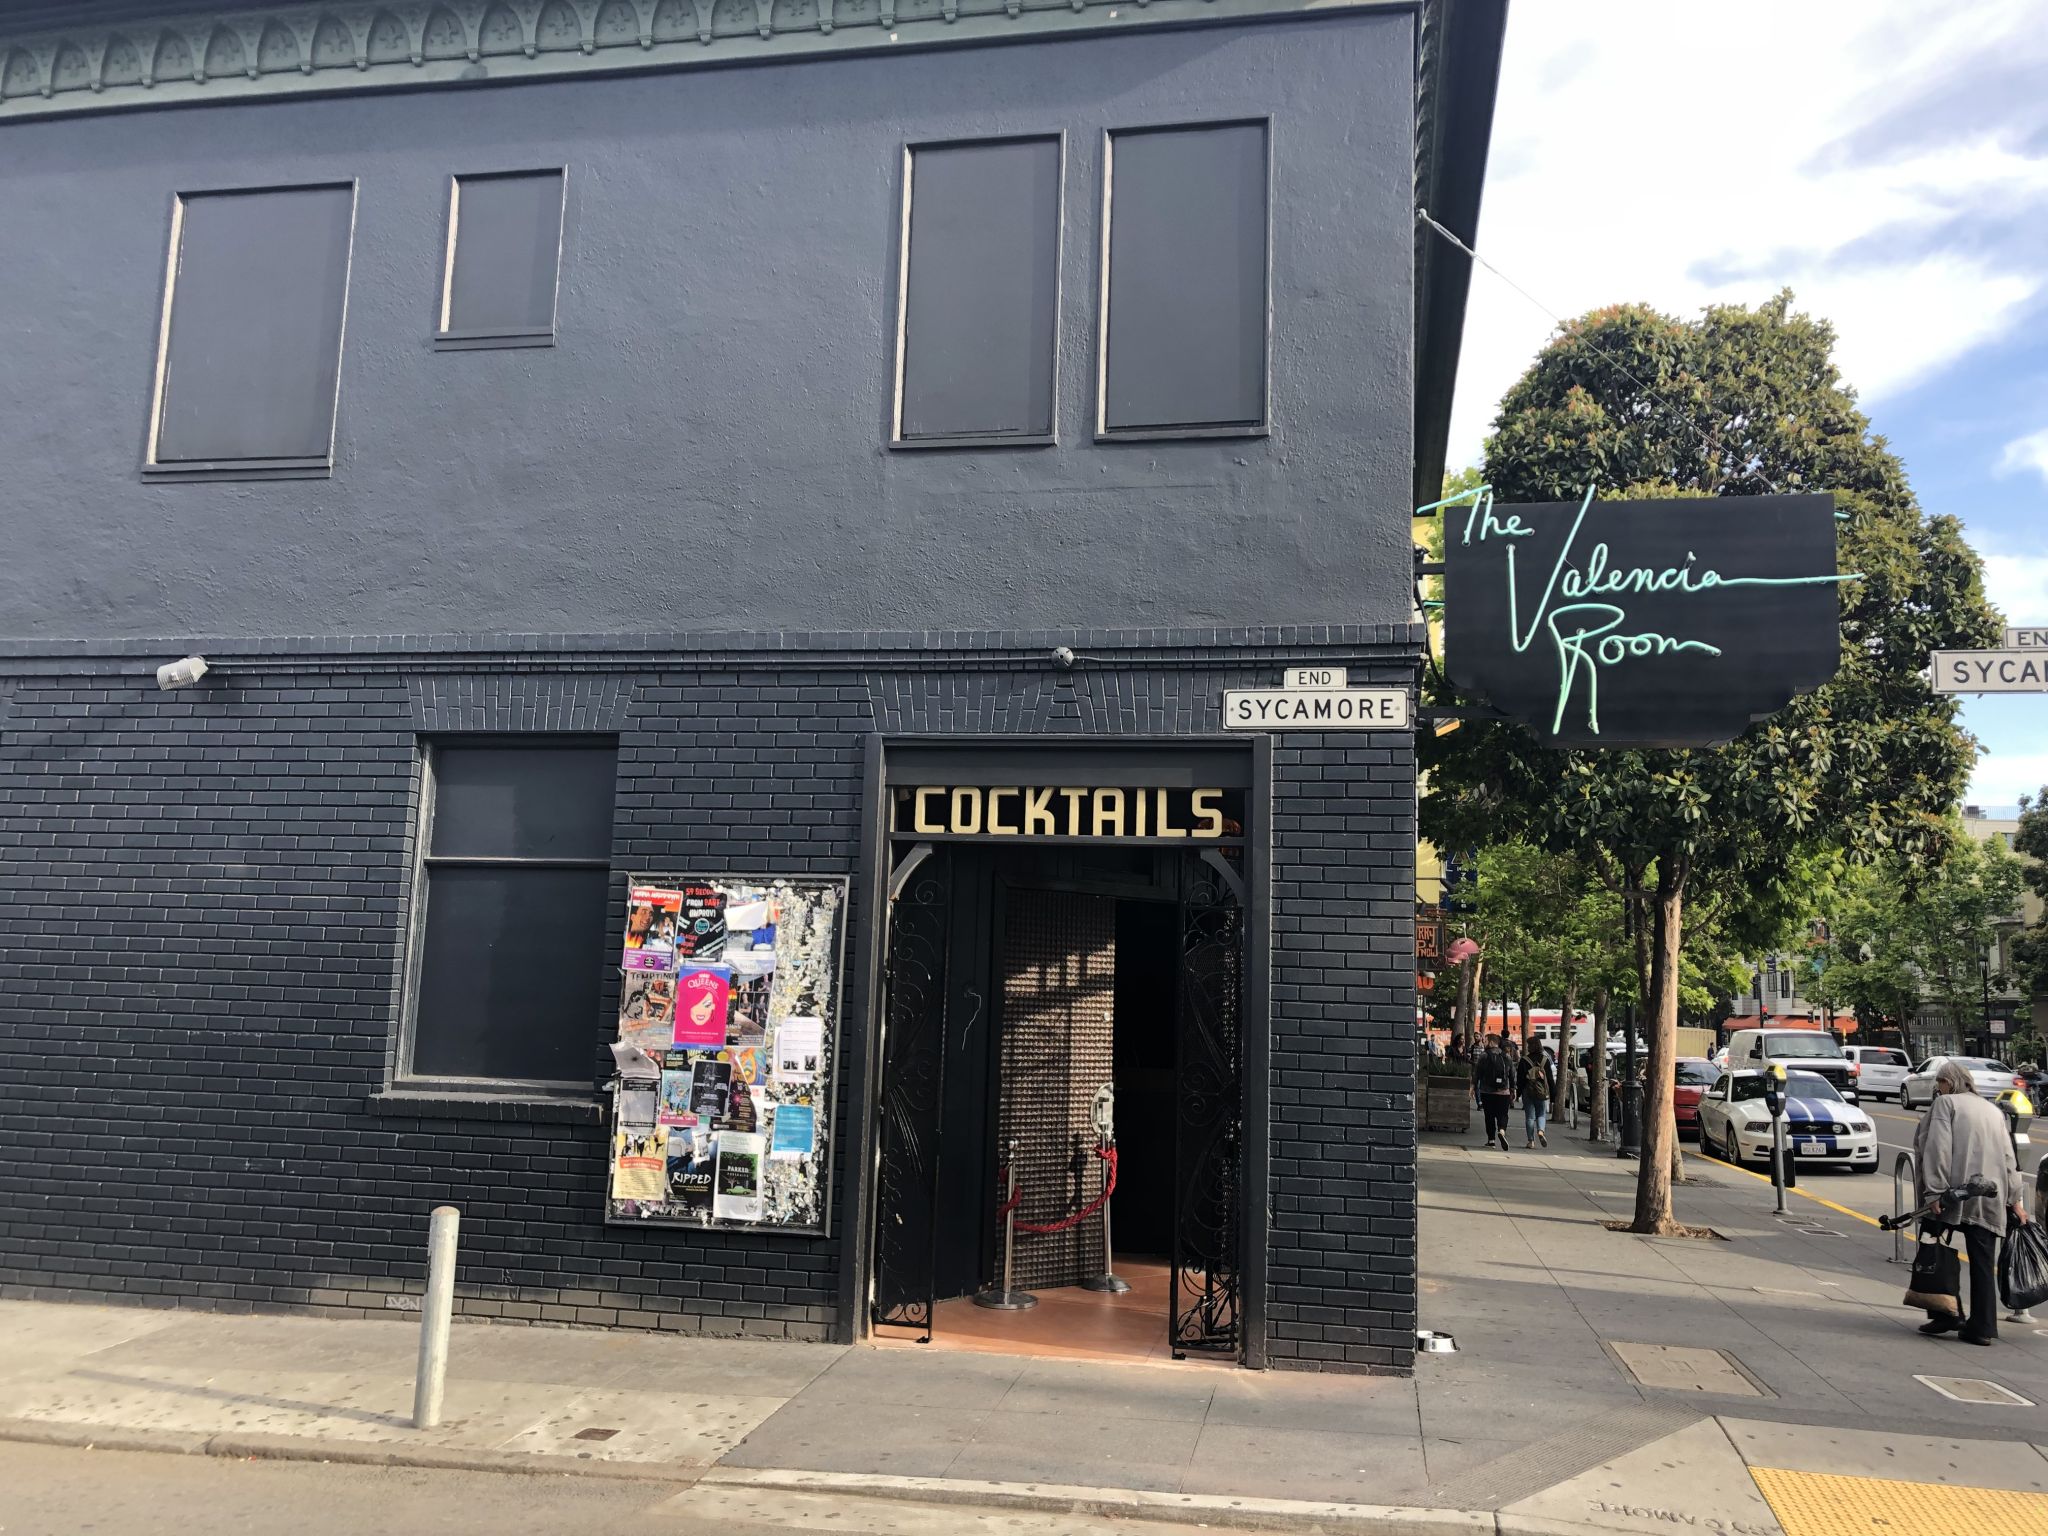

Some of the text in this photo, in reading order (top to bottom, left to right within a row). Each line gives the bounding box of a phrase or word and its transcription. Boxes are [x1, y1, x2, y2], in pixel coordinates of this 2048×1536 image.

[1417, 484, 1535, 546] The
[1506, 484, 1863, 652] Valencia
[1298, 671, 1332, 685] END
[1548, 603, 1723, 735] Room
[1953, 660, 2048, 684] SYCA
[1238, 698, 1394, 720] SYCAMORE
[914, 786, 1224, 838] COCKTAILS
[686, 898, 704, 907] FROM
[687, 978, 720, 990] QUEENS
[671, 1171, 712, 1185] RIPPED
[727, 1165, 749, 1173] PARKED
